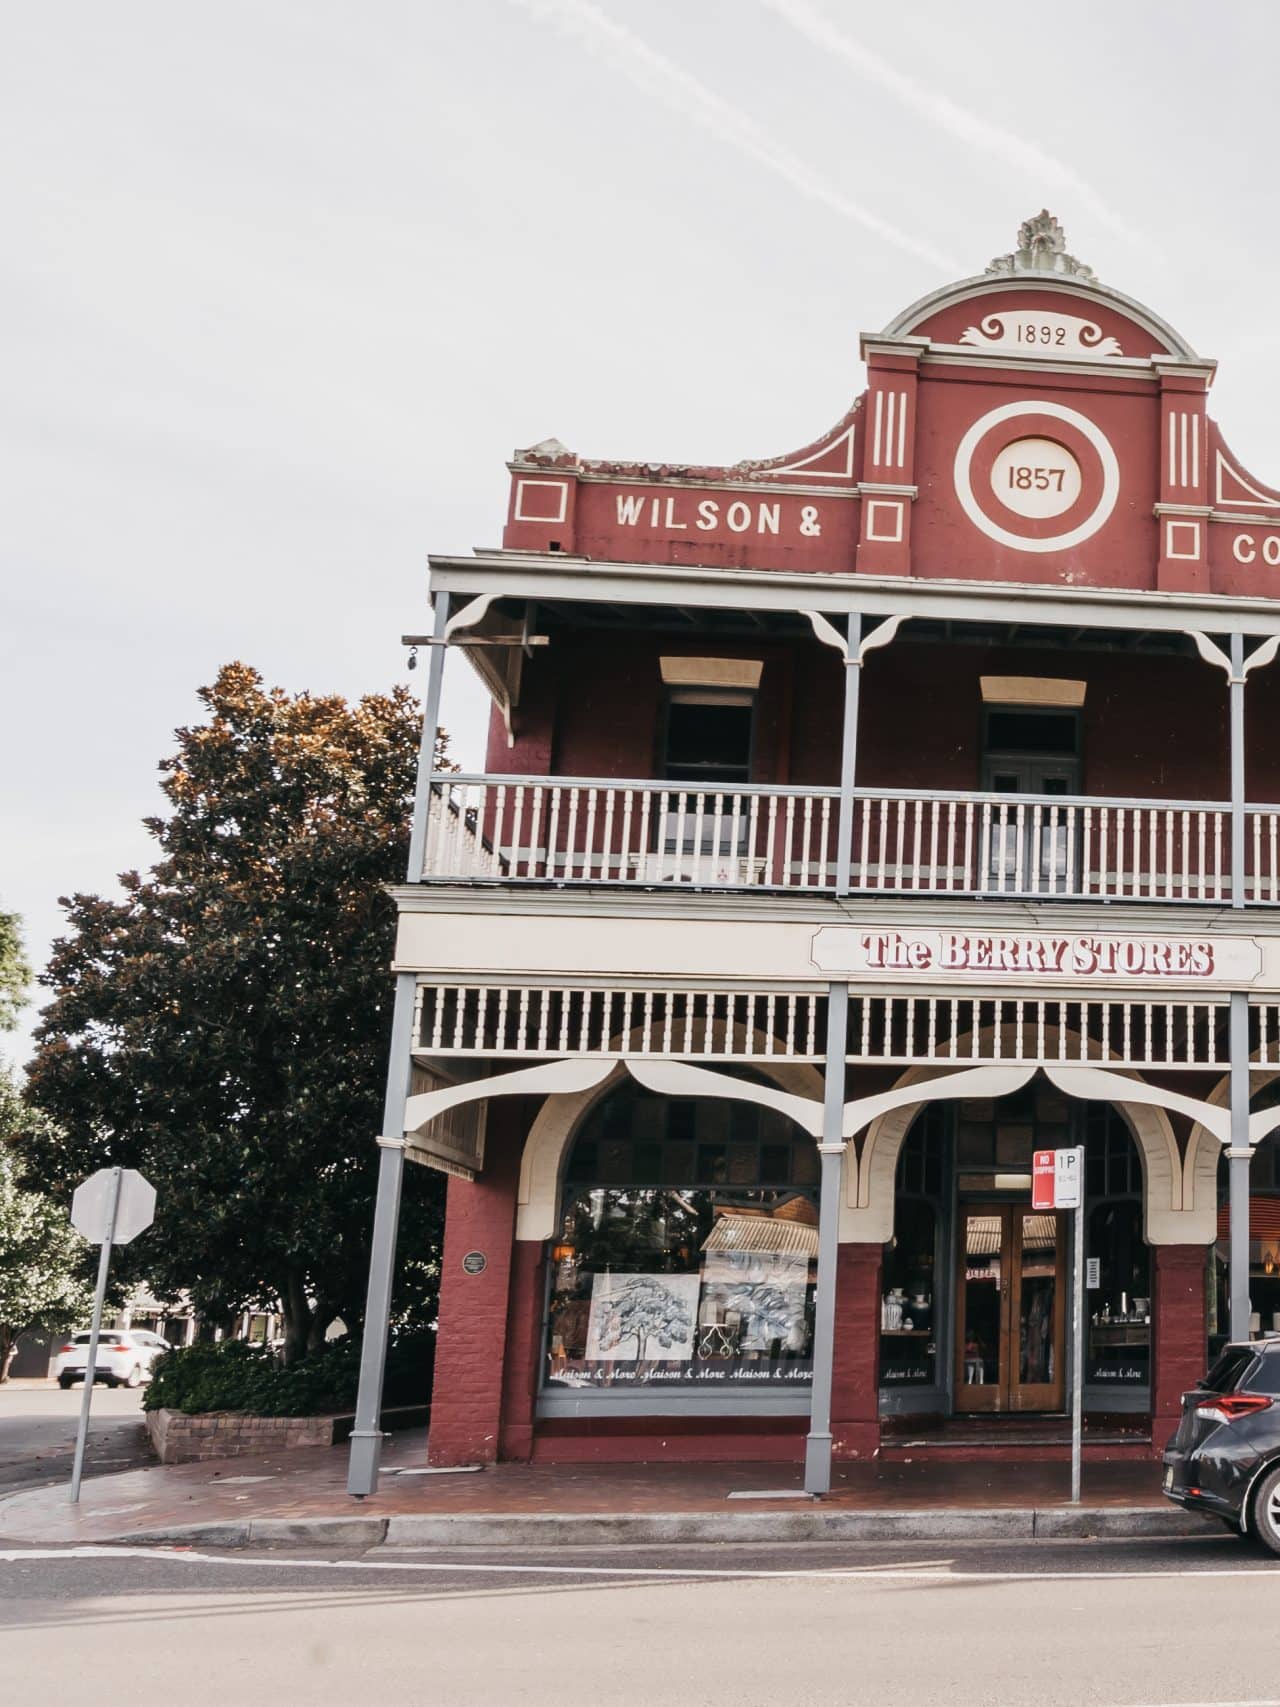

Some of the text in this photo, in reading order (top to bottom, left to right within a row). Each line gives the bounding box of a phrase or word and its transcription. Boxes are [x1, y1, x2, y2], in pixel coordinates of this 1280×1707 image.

[1017, 324, 1067, 346] 1892
[1008, 466, 1066, 492] 1857
[615, 494, 821, 537] WILSON &
[862, 932, 1216, 977] The BERRY STORES
[1060, 1155, 1076, 1169] 1P
[729, 1368, 770, 1380] Maison
